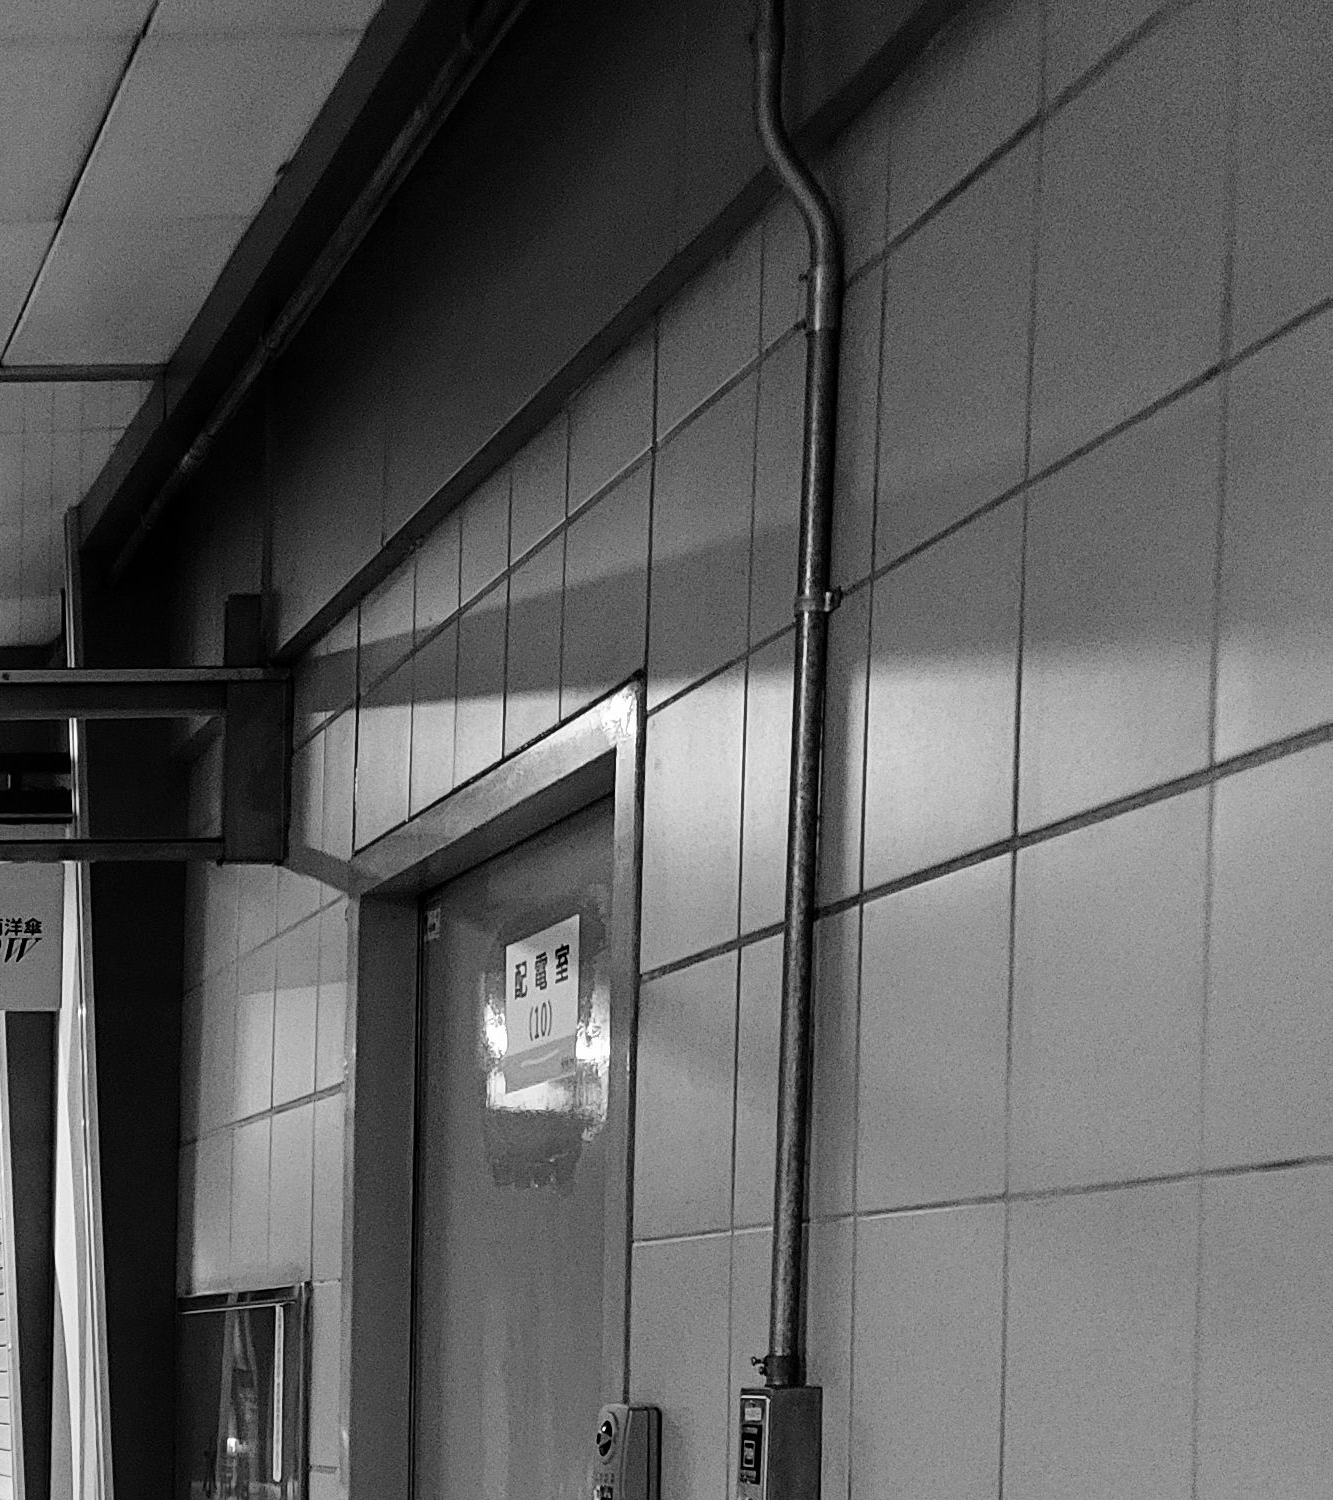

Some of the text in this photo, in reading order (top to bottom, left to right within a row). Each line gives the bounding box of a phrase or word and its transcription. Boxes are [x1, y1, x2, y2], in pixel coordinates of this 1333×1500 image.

[514, 943, 570, 1001] 配電室
[529, 999, 552, 1042] (10)
